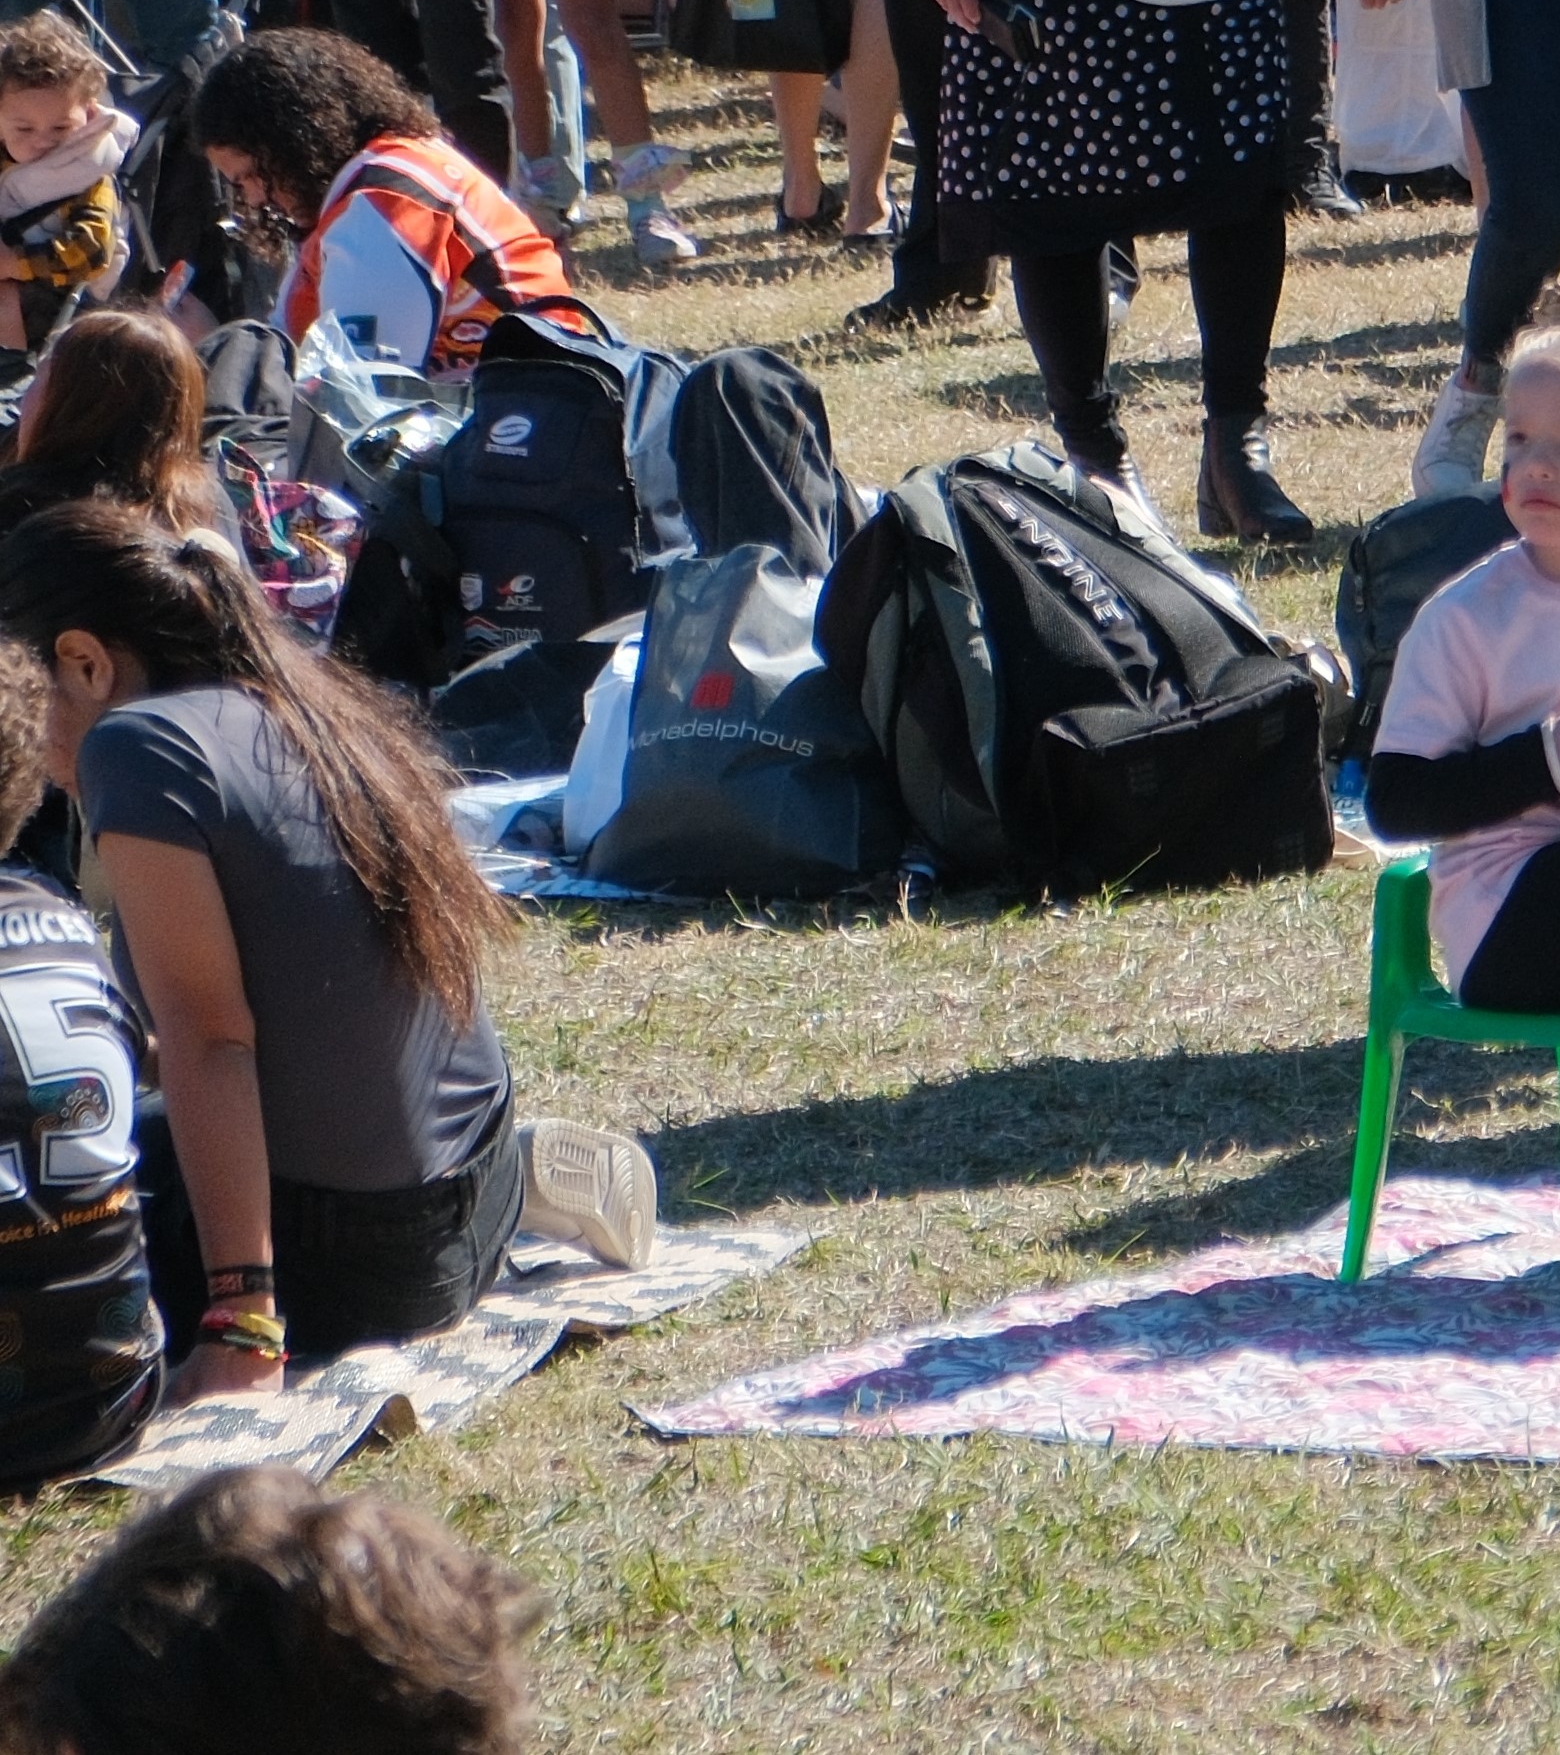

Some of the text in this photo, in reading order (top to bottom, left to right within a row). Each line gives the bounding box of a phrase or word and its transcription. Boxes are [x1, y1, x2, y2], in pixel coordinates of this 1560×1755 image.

[505, 595, 535, 607] ADF
[0, 908, 96, 949] OICES
[0, 961, 140, 1203] 5
[0, 1224, 36, 1245] oice
